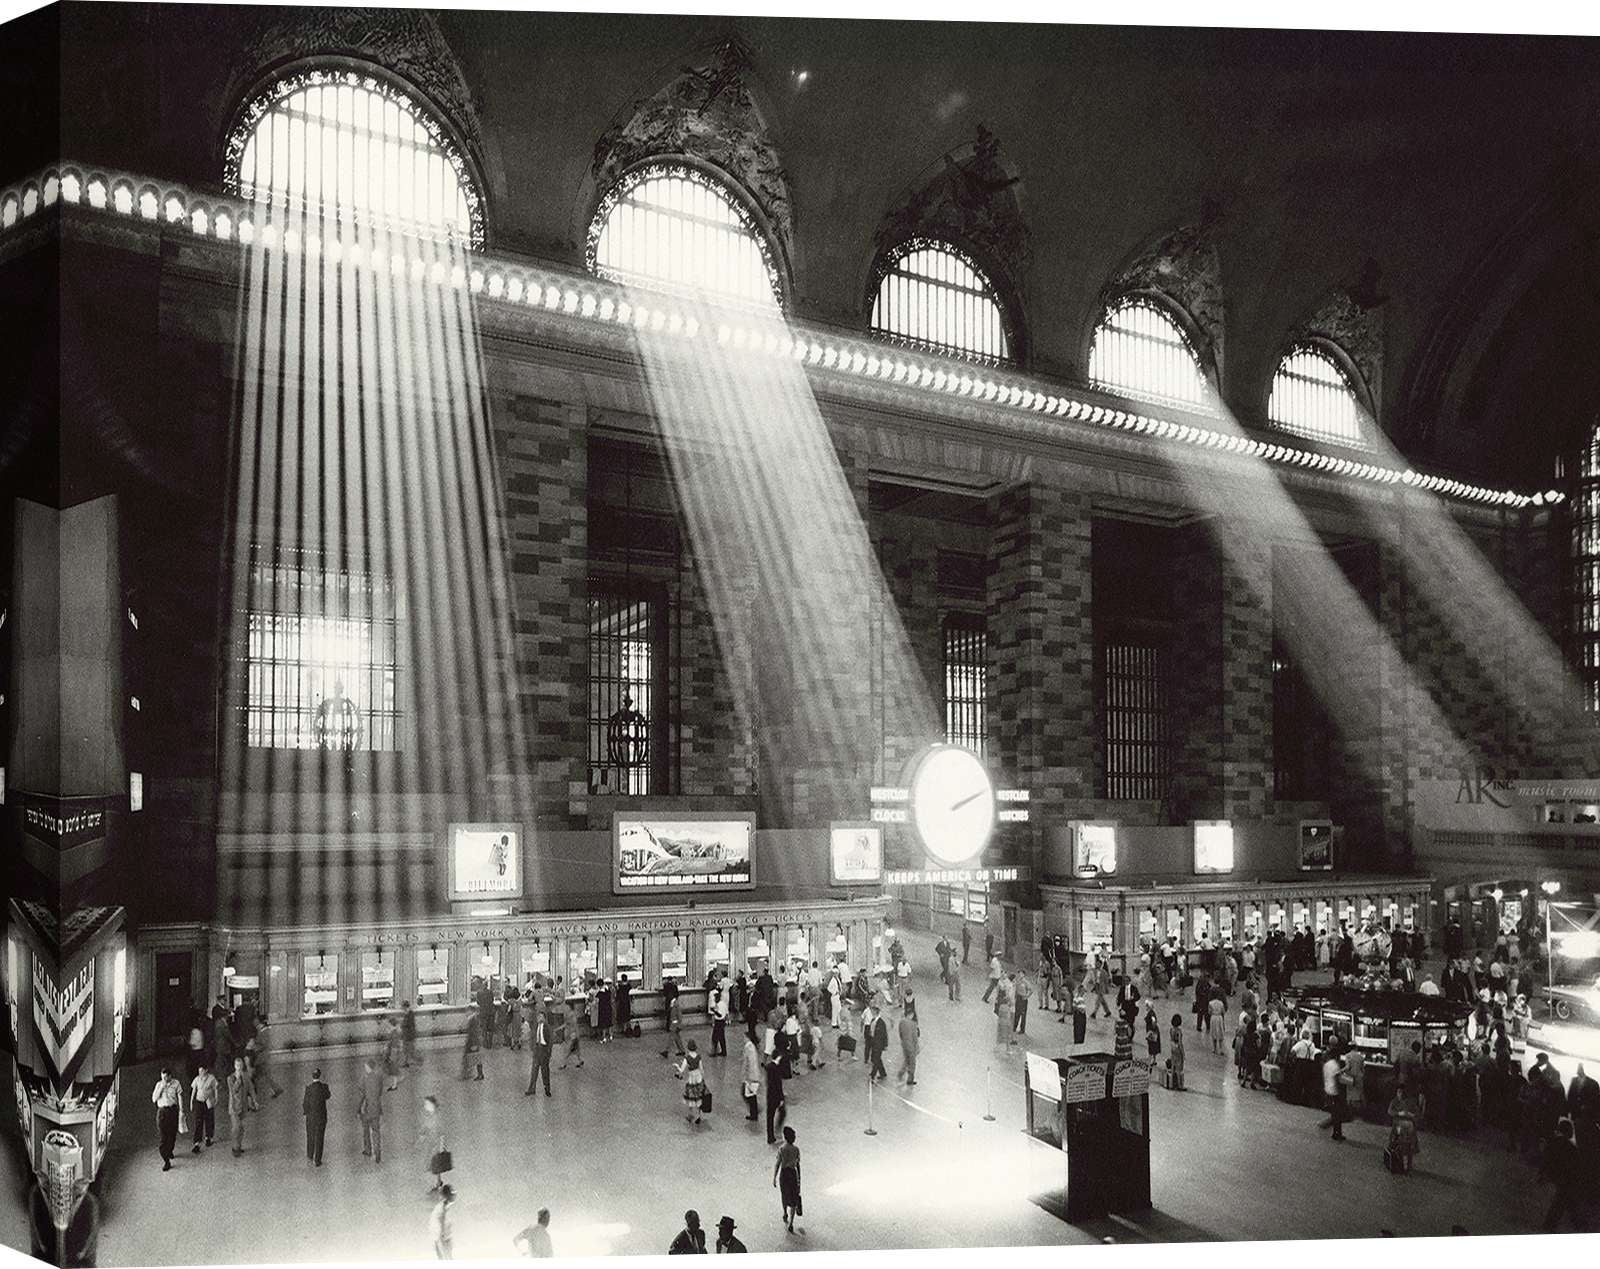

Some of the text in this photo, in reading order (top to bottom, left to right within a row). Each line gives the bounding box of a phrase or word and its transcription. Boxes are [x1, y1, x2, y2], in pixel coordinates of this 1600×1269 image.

[886, 868, 1018, 884] KEEPS AMERICA ON TIME
[367, 933, 420, 944] TICKETS
[438, 930, 465, 940] NEW
[474, 929, 505, 938] YORK
[514, 927, 539, 936] NEW
[551, 924, 588, 934] HAVEN
[598, 923, 619, 932] AND
[628, 919, 681, 930] HARTFORD
[689, 917, 737, 927] RAILROAD
[774, 913, 813, 923] TICKETS
